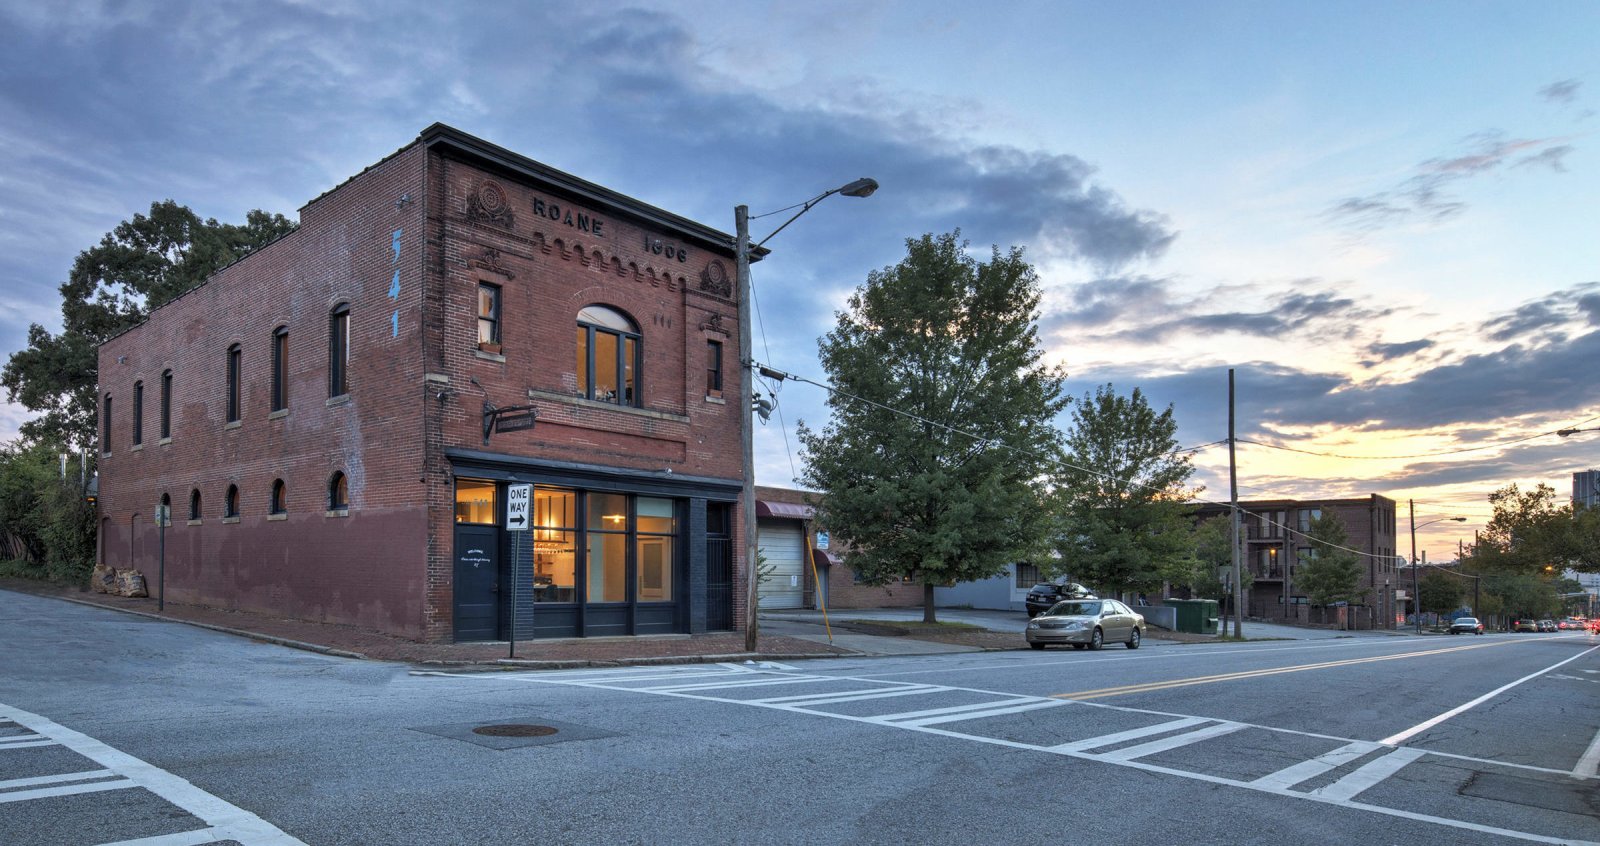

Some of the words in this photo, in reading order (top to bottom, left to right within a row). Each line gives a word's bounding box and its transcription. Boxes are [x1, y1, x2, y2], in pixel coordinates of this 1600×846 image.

[533, 197, 604, 237] ROANE
[510, 488, 527, 499] ONE
[509, 502, 527, 513] WAY
